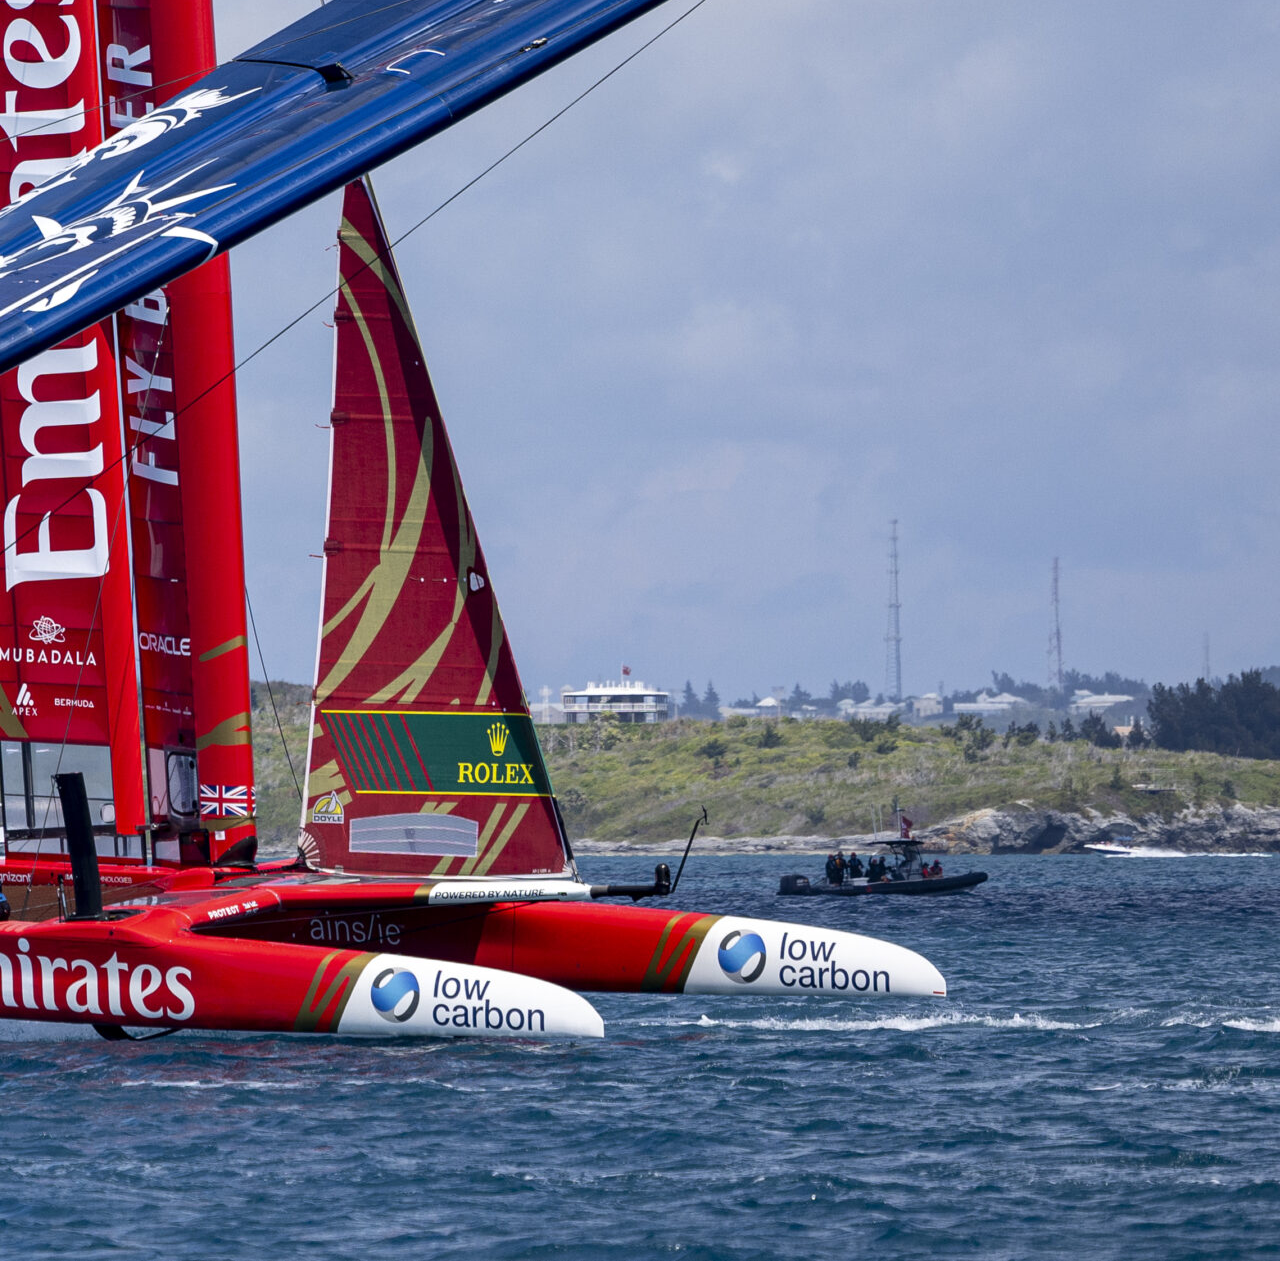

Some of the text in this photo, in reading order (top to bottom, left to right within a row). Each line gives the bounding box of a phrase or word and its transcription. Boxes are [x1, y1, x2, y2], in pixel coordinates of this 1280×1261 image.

[125, 356, 179, 486] FLY
[139, 632, 191, 656] ORACLE
[0, 647, 96, 666] MUBADALA
[11, 707, 38, 716] APEX
[54, 698, 95, 708] BERMUDA
[457, 762, 535, 785] ROLEX
[313, 815, 344, 823] DOYLE
[434, 889, 545, 899] POWERED BY NATURE
[207, 904, 240, 920] PROTECT
[779, 931, 837, 963] low
[433, 970, 490, 1001] low
[778, 961, 890, 992] carbon
[432, 999, 546, 1032] carbon
